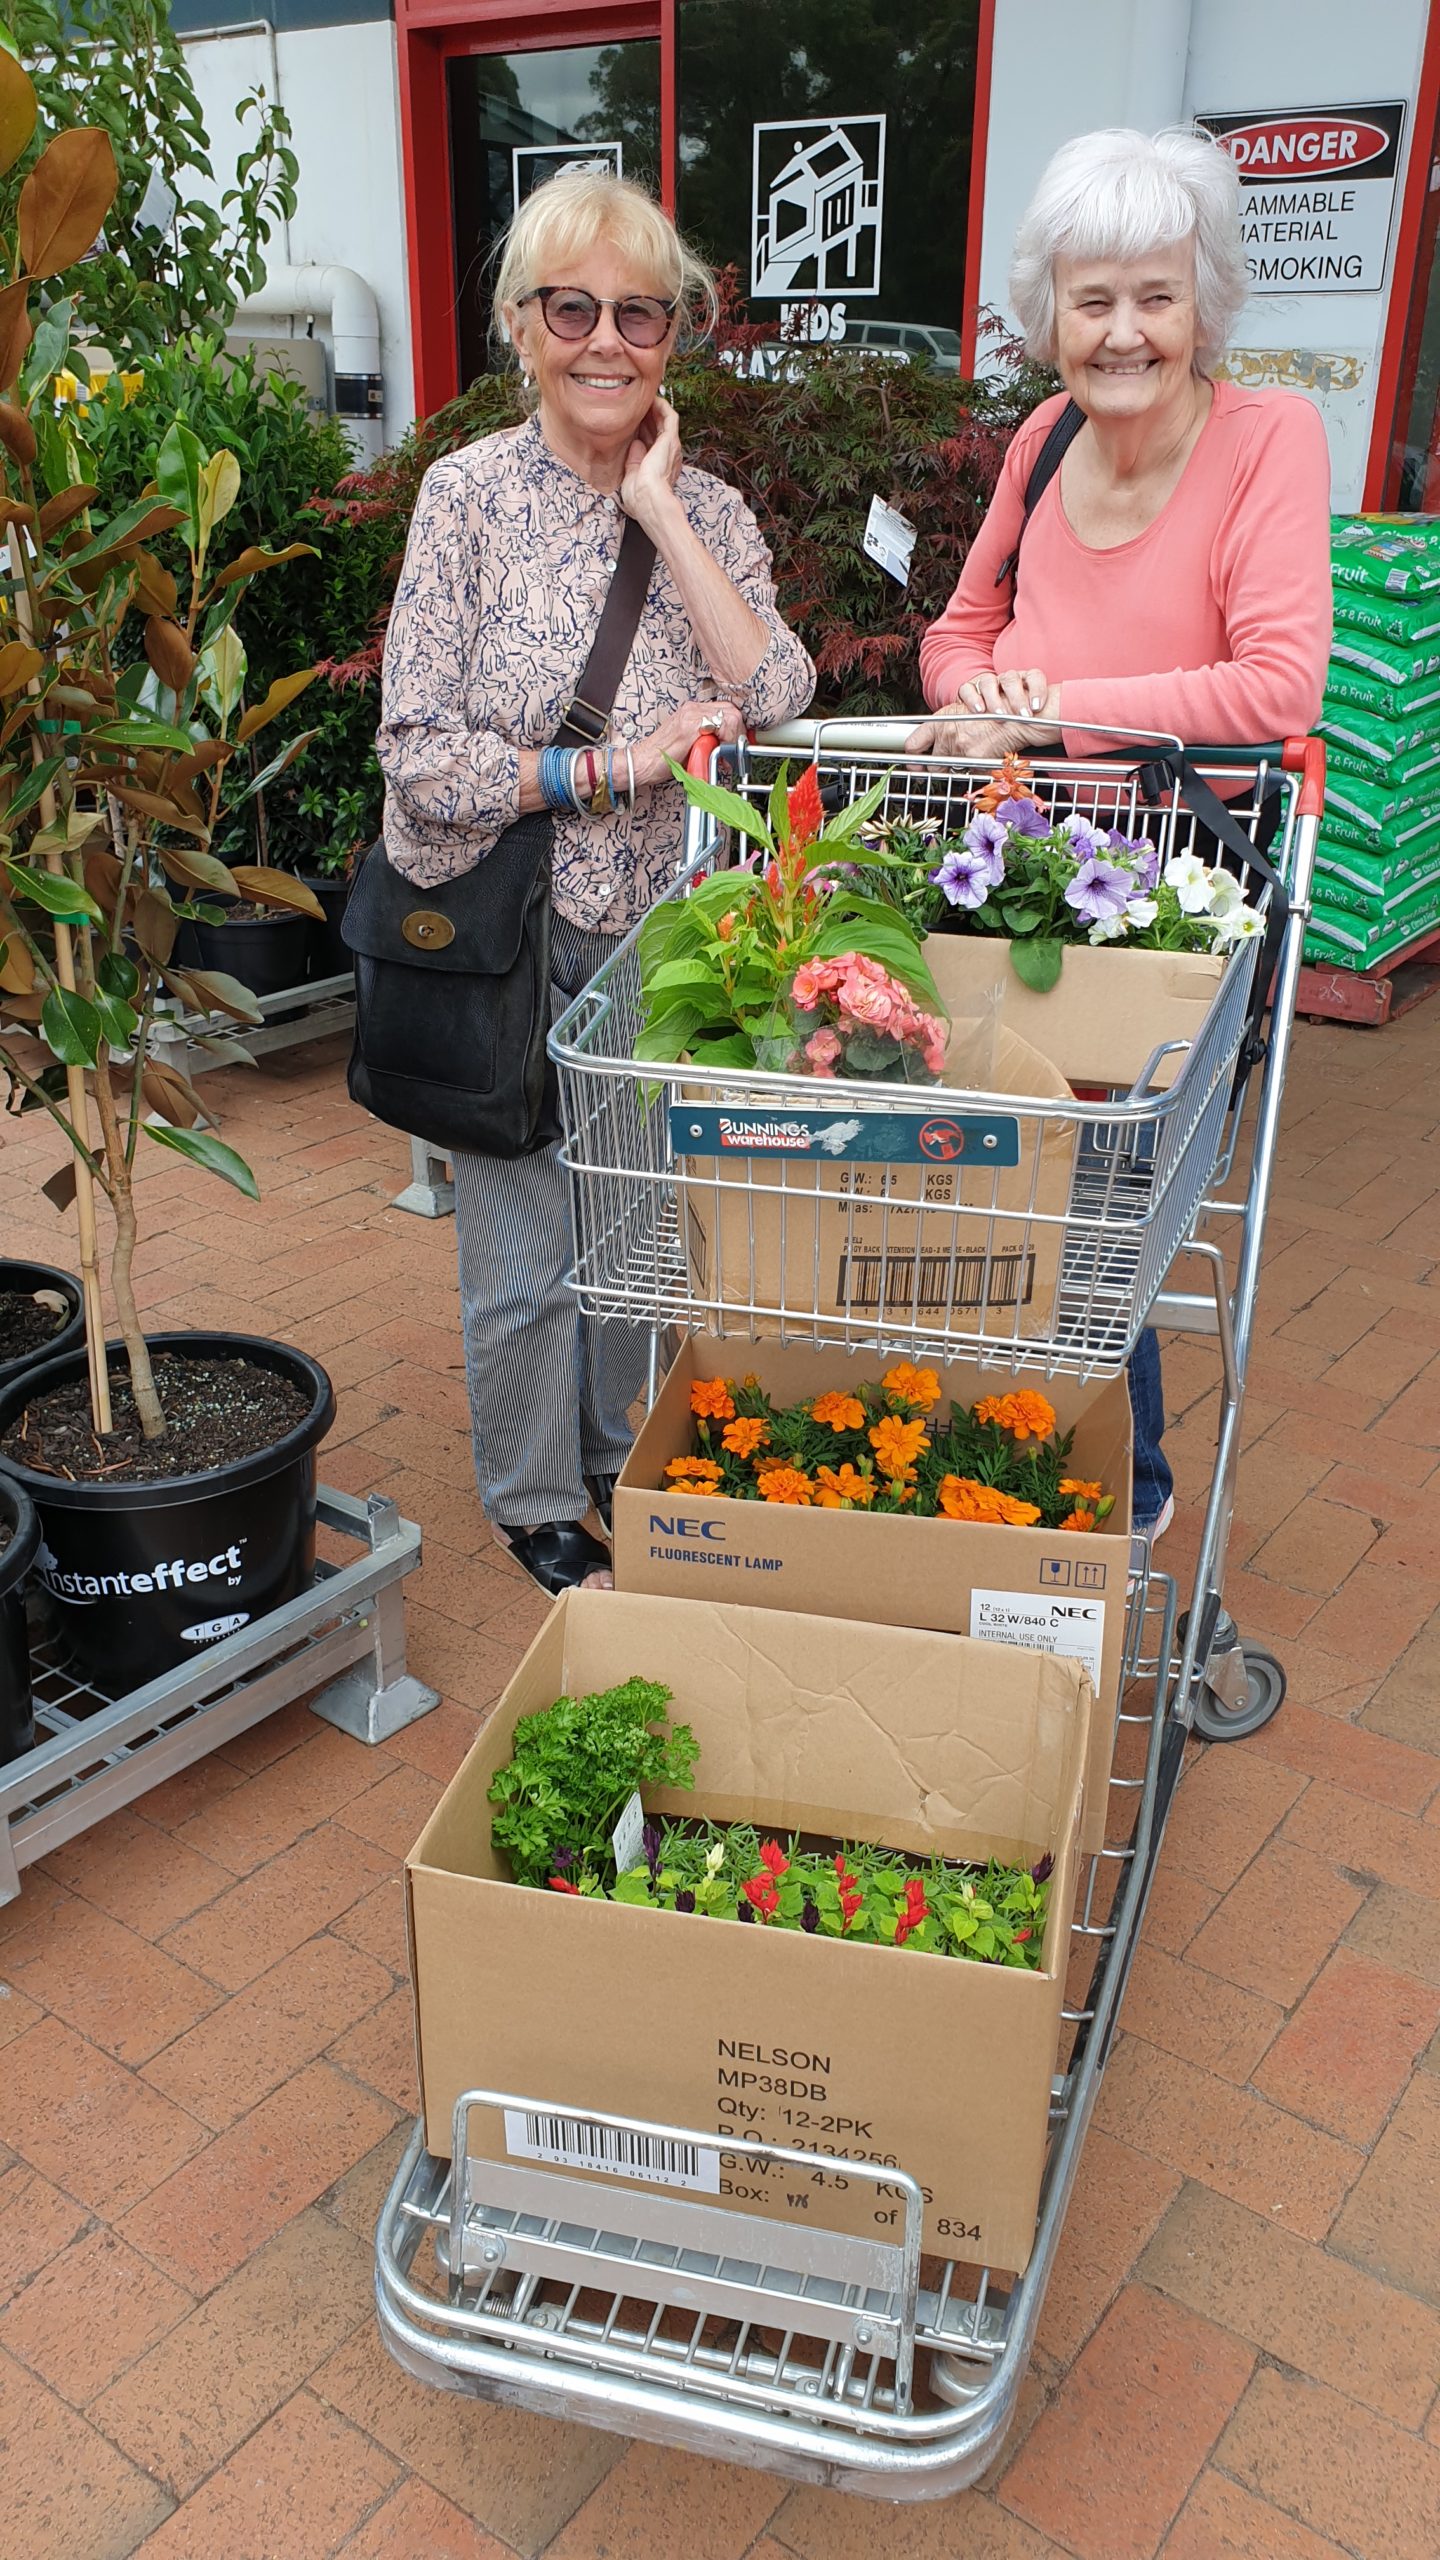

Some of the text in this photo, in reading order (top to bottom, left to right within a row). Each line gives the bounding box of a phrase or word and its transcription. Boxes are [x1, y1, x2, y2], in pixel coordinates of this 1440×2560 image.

[1230, 130, 1358, 166] DANGER
[1238, 190, 1356, 217] AMMABLE
[1245, 255, 1362, 281] SMOKING
[1330, 562, 1369, 583] Fruit
[1350, 688, 1375, 702] Fruit
[1343, 757, 1368, 772] Fruit
[1335, 825, 1360, 840] Fruit
[1325, 889, 1349, 903] Fruit
[719, 1118, 809, 1137] BUNNINGS
[727, 1133, 805, 1147] warehouse
[840, 1172, 953, 1186] GW.: 65 KGS
[925, 1189, 951, 1200] KGS
[838, 1202, 872, 1213] Mas:
[886, 1246, 915, 1254] XTENSION
[650, 1515, 726, 1541] NEC
[650, 1546, 783, 1572] FLUORESCENT LAMP
[228, 1574, 242, 1587] by
[980, 1603, 990, 1611] 12
[1051, 1606, 1096, 1620] NEC
[980, 1613, 987, 1621] L
[991, 1613, 1005, 1623] 32
[1050, 1618, 1059, 1627] C
[979, 1629, 1058, 1643] INTERNAL USE ONLY
[717, 2038, 832, 2074] NELSON
[717, 2067, 828, 2101] MP38DB
[718, 2097, 872, 2139] Qty: 12-2PK
[719, 2153, 784, 2179] G.W.:
[811, 2171, 849, 2189] 4.5
[719, 2178, 769, 2202] Box:
[874, 2210, 898, 2225] of
[937, 2218, 981, 2241] 834
